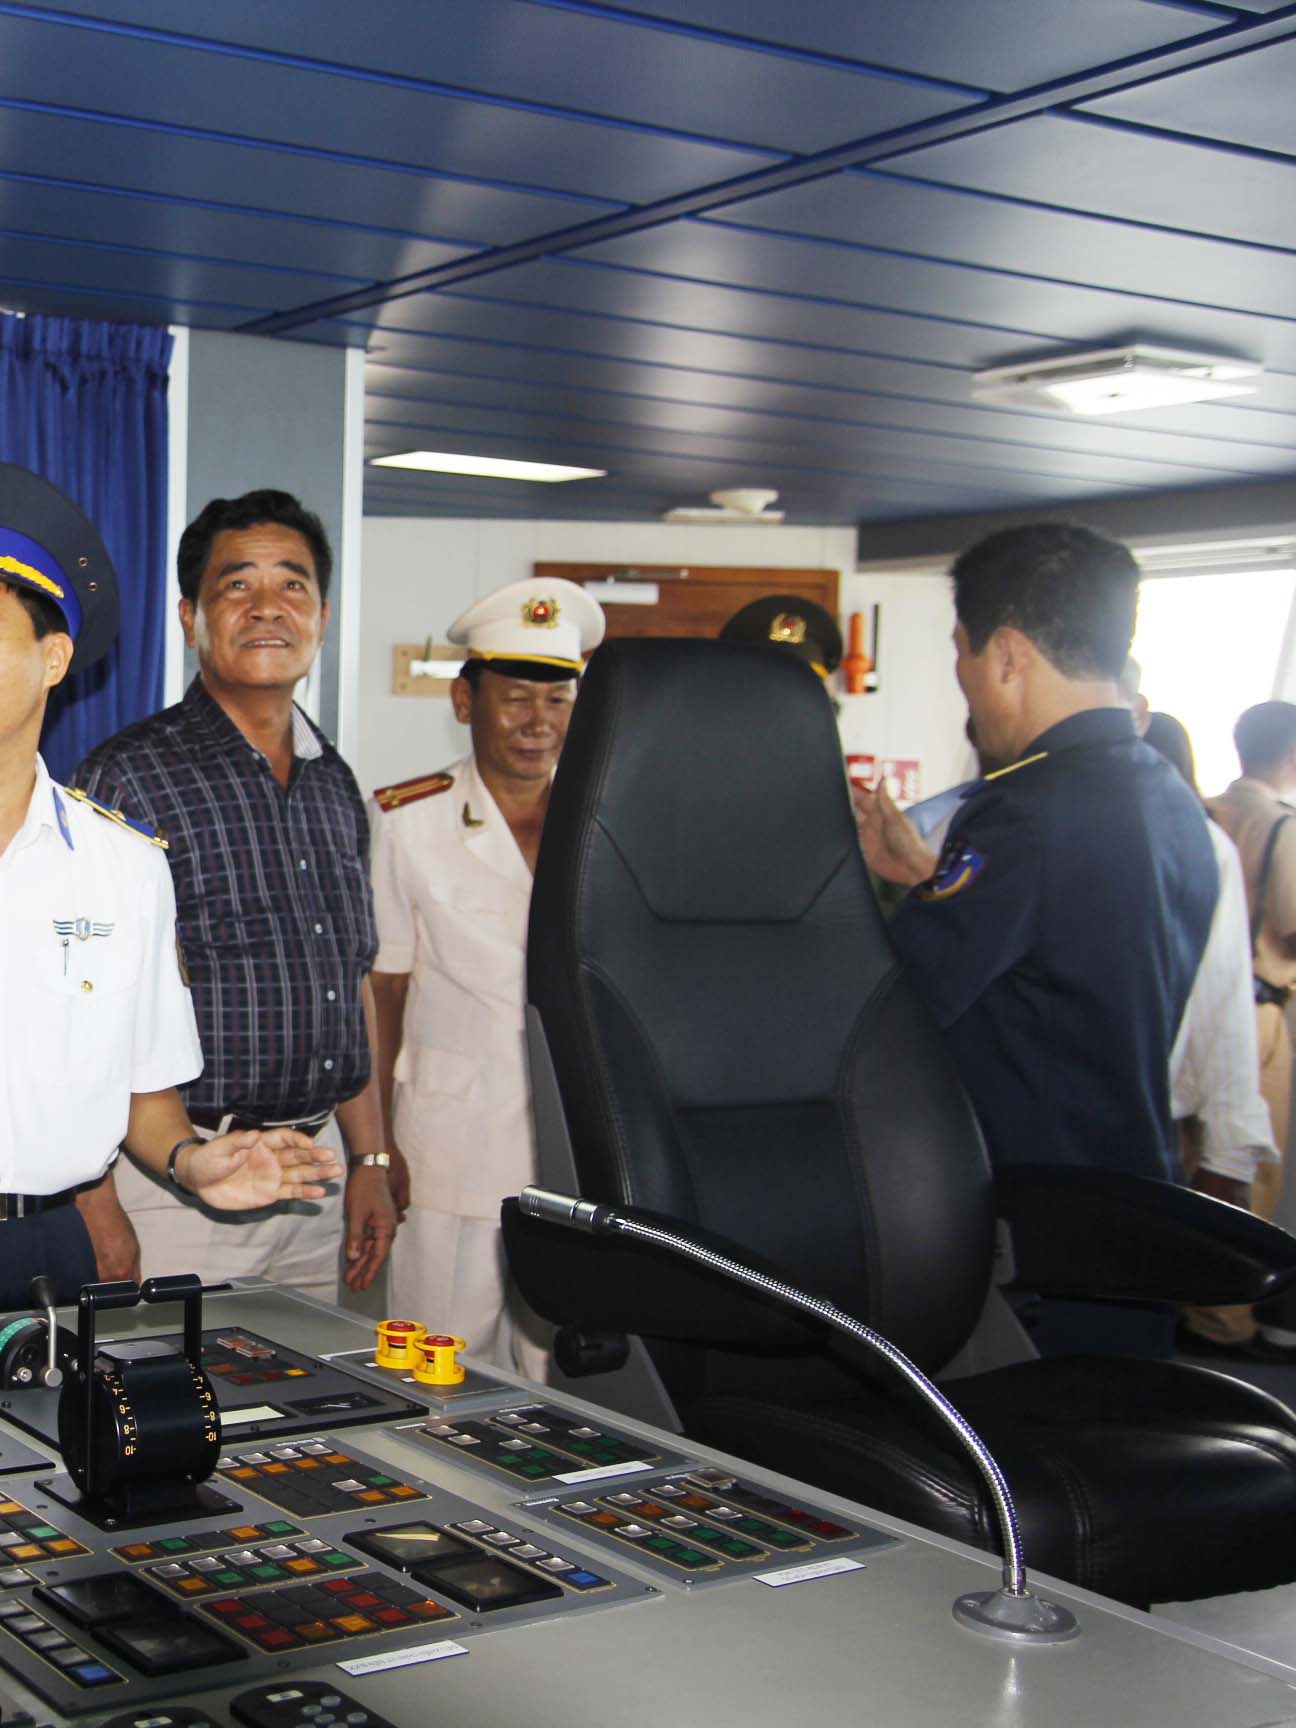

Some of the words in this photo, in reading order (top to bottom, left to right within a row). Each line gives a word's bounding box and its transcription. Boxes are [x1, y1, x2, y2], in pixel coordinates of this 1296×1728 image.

[205, 1392, 212, 1401] 6
[119, 1405, 126, 1414] 6
[209, 1411, 215, 1421] 8
[123, 1425, 130, 1435] 8
[208, 1431, 217, 1442] 10
[125, 1445, 134, 1455] 10
